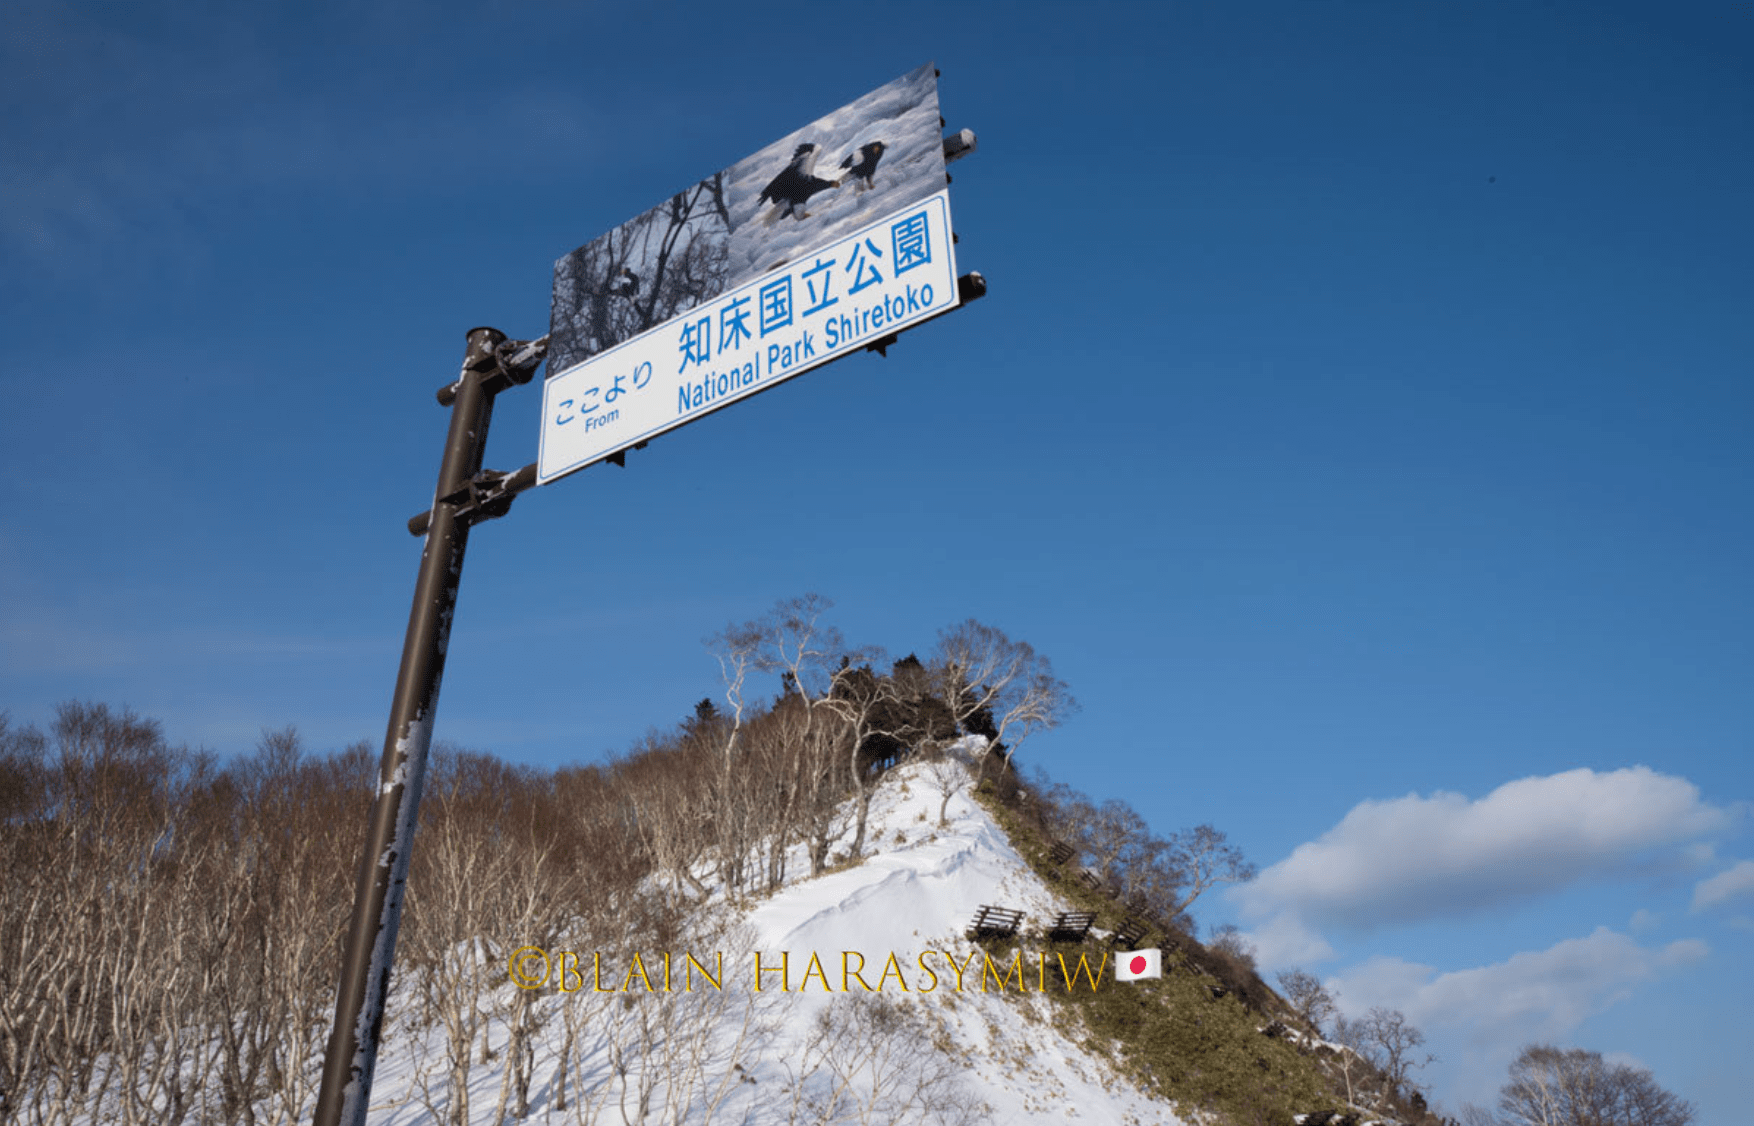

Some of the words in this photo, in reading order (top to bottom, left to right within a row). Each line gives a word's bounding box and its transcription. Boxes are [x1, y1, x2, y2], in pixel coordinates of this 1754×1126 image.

[678, 211, 932, 375] 知床国立公園
[556, 361, 653, 426] ここより
[678, 352, 760, 414] National
[767, 330, 816, 375] Park
[825, 283, 935, 349] Shiretoko
[585, 409, 620, 433] From
